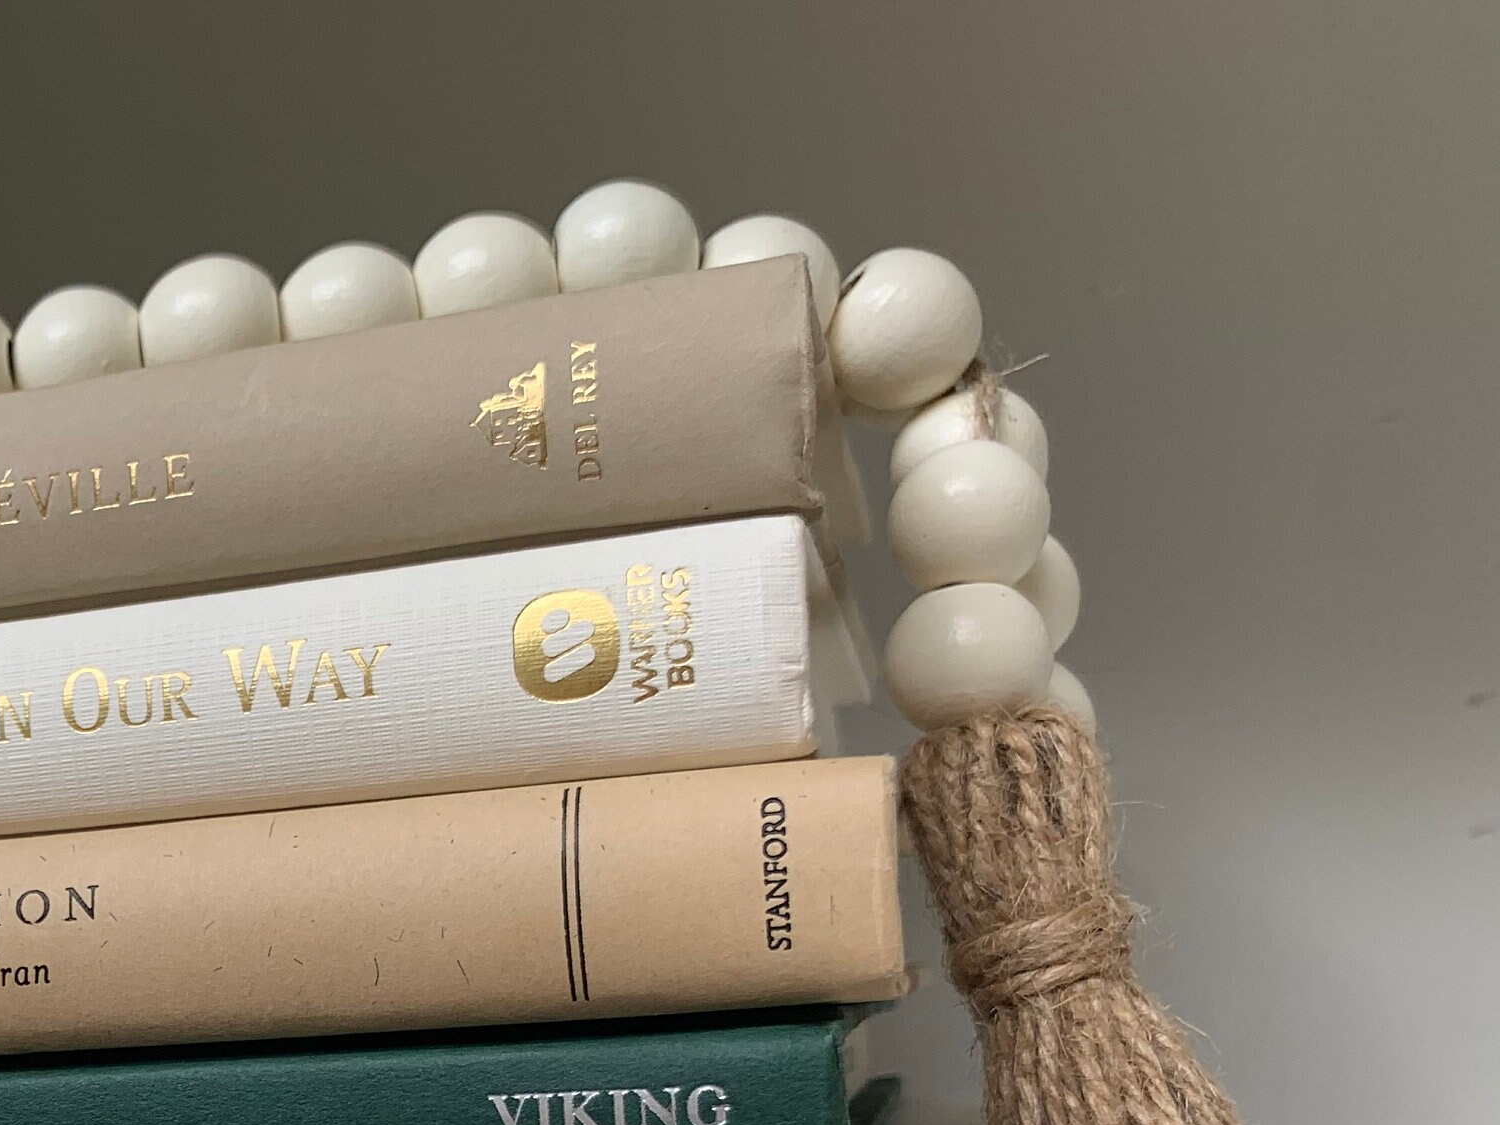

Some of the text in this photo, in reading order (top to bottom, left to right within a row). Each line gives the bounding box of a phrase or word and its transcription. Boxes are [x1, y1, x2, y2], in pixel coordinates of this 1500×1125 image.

[571, 340, 602, 482] DEL REY
[661, 567, 695, 689] BOOKS
[762, 796, 791, 951] STANFORD
